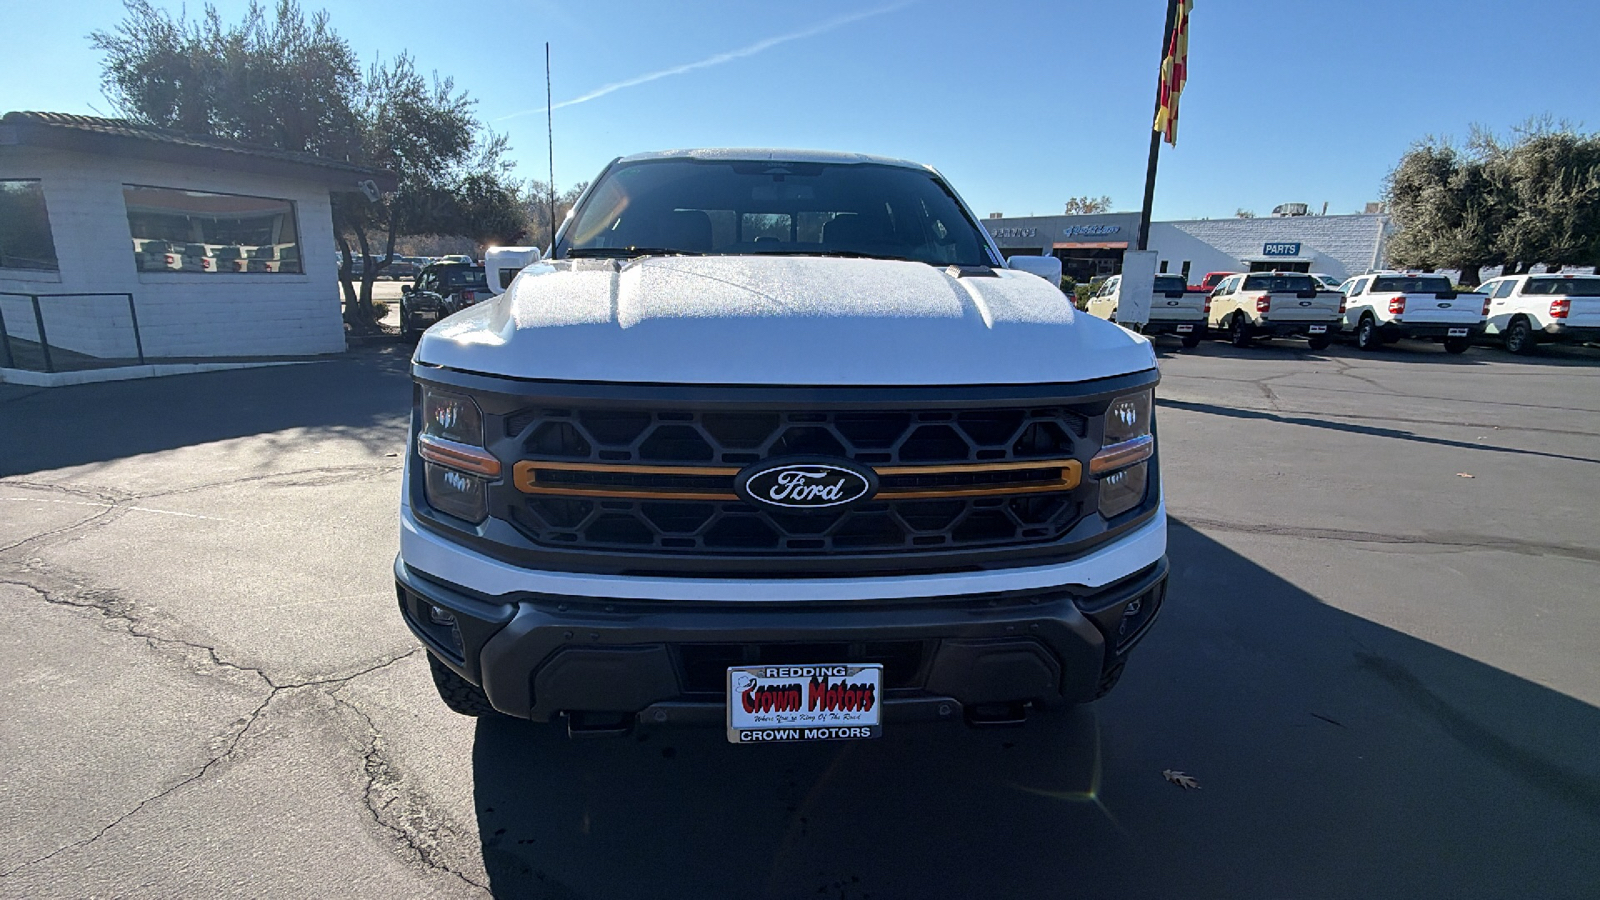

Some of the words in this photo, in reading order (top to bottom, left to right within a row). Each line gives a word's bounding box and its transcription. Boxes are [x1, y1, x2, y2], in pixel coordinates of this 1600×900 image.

[1265, 244, 1296, 254] PARTS
[770, 471, 845, 500] Ford
[766, 667, 846, 678] REDDING
[742, 681, 802, 713] Crown
[808, 678, 875, 712] Motors
[817, 713, 827, 722] Of
[741, 729, 799, 741] CROWN
[804, 727, 871, 739] MOTORS
